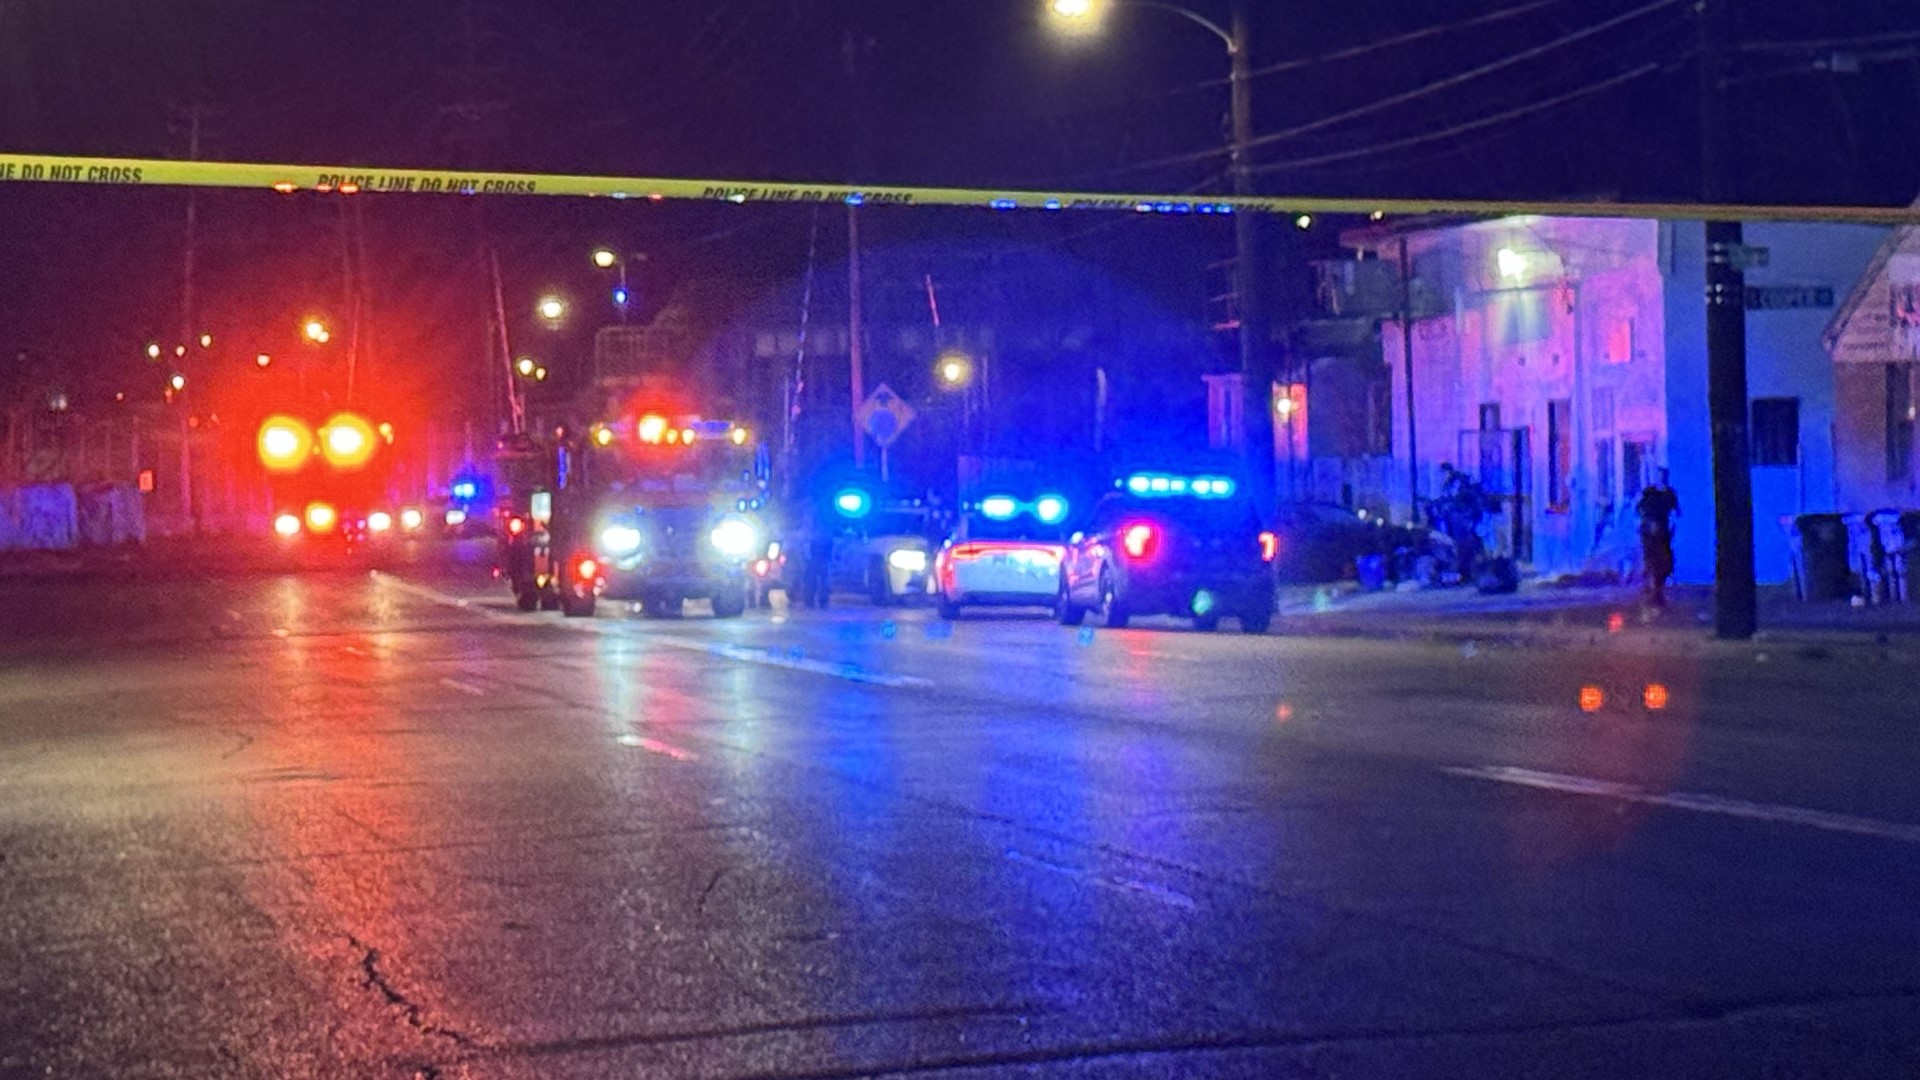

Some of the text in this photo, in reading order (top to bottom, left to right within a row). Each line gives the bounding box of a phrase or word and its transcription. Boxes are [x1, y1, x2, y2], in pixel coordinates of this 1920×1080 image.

[22, 163, 44, 179] DO
[50, 164, 82, 180] NOT
[88, 165, 143, 182] CROSS
[379, 176, 415, 190] LINE
[420, 177, 442, 190] DO
[447, 178, 479, 191] NOT
[483, 179, 536, 193] CROSS
